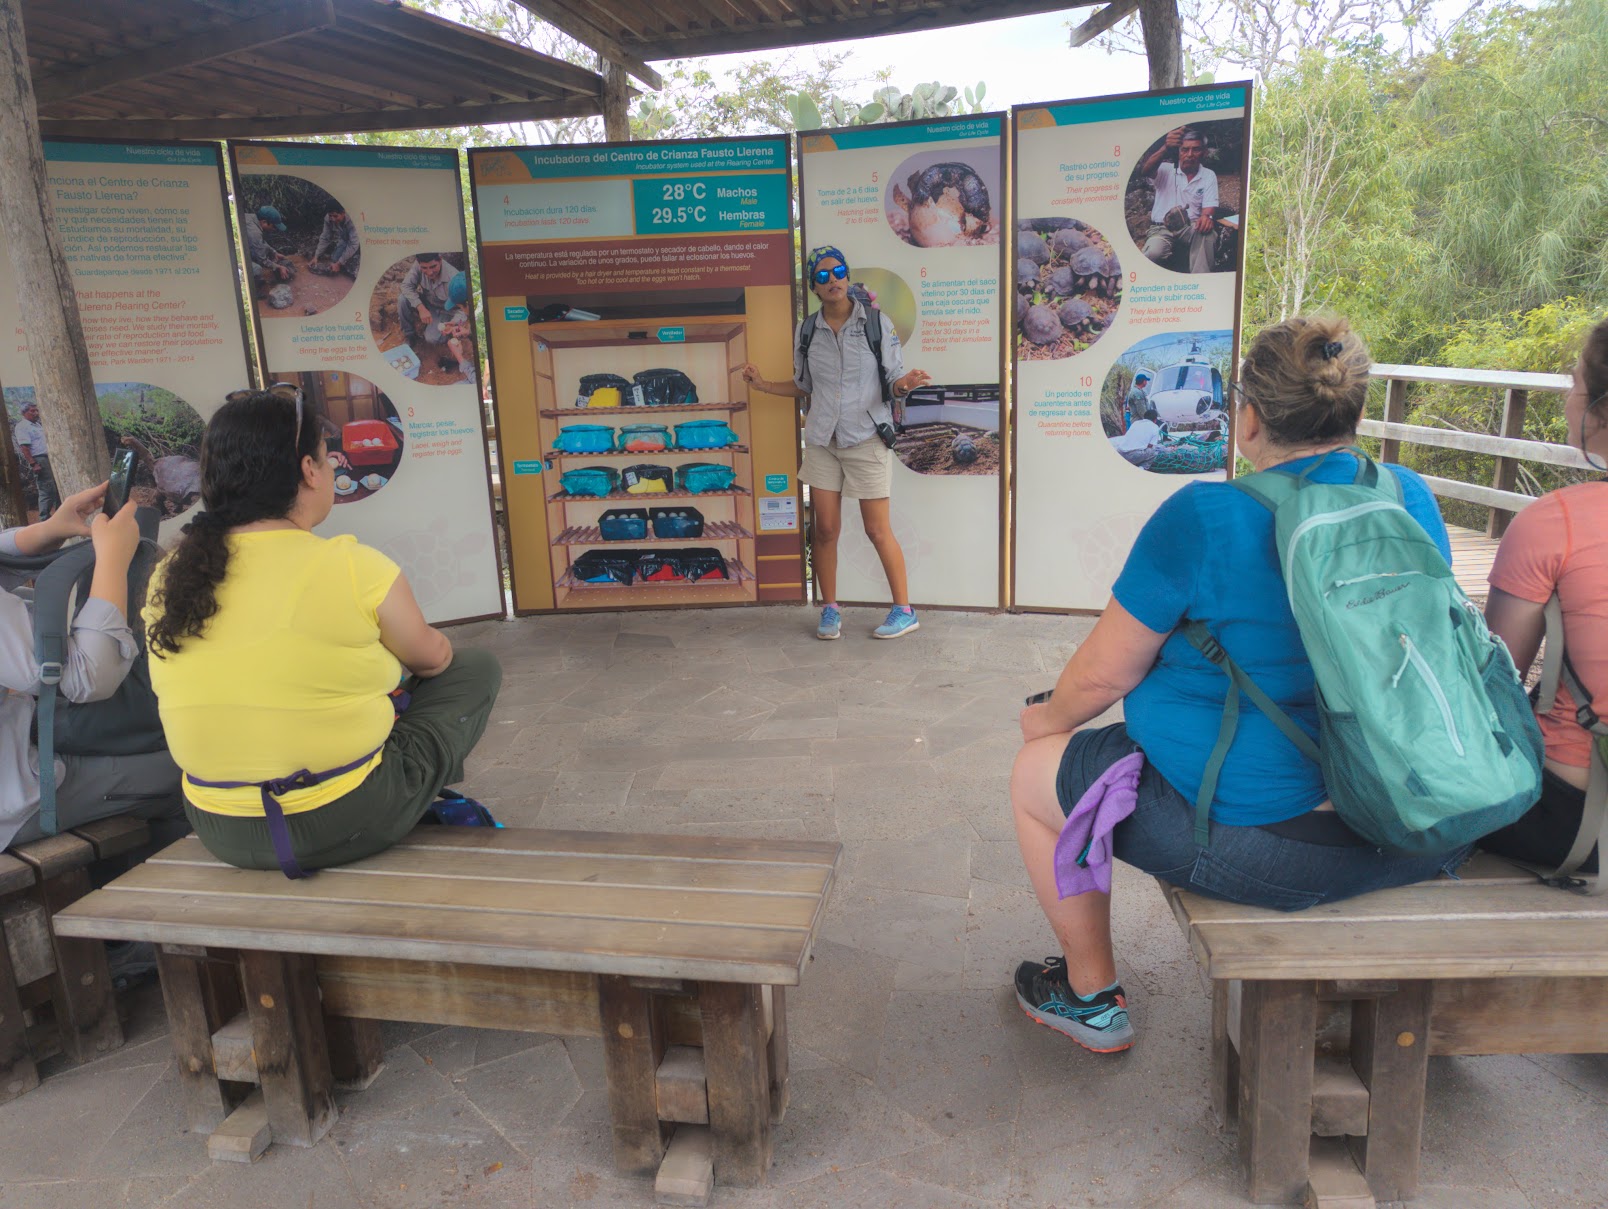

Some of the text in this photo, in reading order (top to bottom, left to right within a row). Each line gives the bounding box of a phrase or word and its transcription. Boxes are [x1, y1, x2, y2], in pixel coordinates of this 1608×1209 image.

[1160, 97, 1186, 106] Nuestro
[1187, 95, 1204, 103] ciclo
[1216, 92, 1230, 100] vida
[951, 123, 966, 131] ciclo
[126, 147, 156, 155] Nuestro
[156, 148, 174, 156] ciclo
[534, 146, 774, 164] Incubadora del Centro de Crianza Fausto Llerena
[1114, 145, 1120, 157] 8
[667, 162, 689, 170] system
[726, 159, 751, 168] Rearing
[1060, 162, 1088, 172] Rastreo
[872, 172, 878, 183] 5
[1065, 174, 1074, 182] de
[1086, 171, 1120, 181] progreso.
[87, 177, 96, 186] el
[99, 177, 134, 187] Centro
[136, 178, 149, 187] de
[151, 178, 189, 188] Crianza
[56, 190, 138, 200] Fausto Llerena?
[663, 182, 757, 200] 28°C Machos
[504, 195, 509, 205] 4
[546, 206, 563, 214] dura
[565, 205, 579, 213] 120
[652, 206, 765, 224] 29.5°C Hembras
[360, 212, 365, 222] 1
[59, 224, 112, 233] Estudiamos
[740, 220, 765, 228] Female
[514, 252, 553, 261] temperatura
[554, 250, 568, 258] está
[569, 249, 597, 259] regulada
[620, 247, 654, 255] termostato
[698, 244, 722, 252] cabello,
[724, 243, 744, 251] dando
[752, 242, 769, 250] calor
[920, 267, 927, 278] 6
[1130, 272, 1136, 283] 9
[921, 280, 930, 288] Se
[932, 280, 965, 288] alimentan
[1130, 284, 1166, 294] Aprenden
[1173, 283, 1199, 291] buscar
[95, 290, 134, 300] happens
[136, 290, 144, 298] at
[147, 289, 160, 297] the
[960, 288, 969, 296] 30
[951, 298, 975, 306] oscura
[1129, 295, 1156, 303] comida
[1164, 293, 1182, 301] subir
[79, 300, 186, 312] Llerena Rearing Center?
[1130, 308, 1146, 316] They
[1187, 305, 1203, 313] food
[355, 311, 362, 322] 2
[301, 325, 324, 333] Llevar
[1080, 376, 1092, 387] 10
[408, 407, 414, 417] 3
